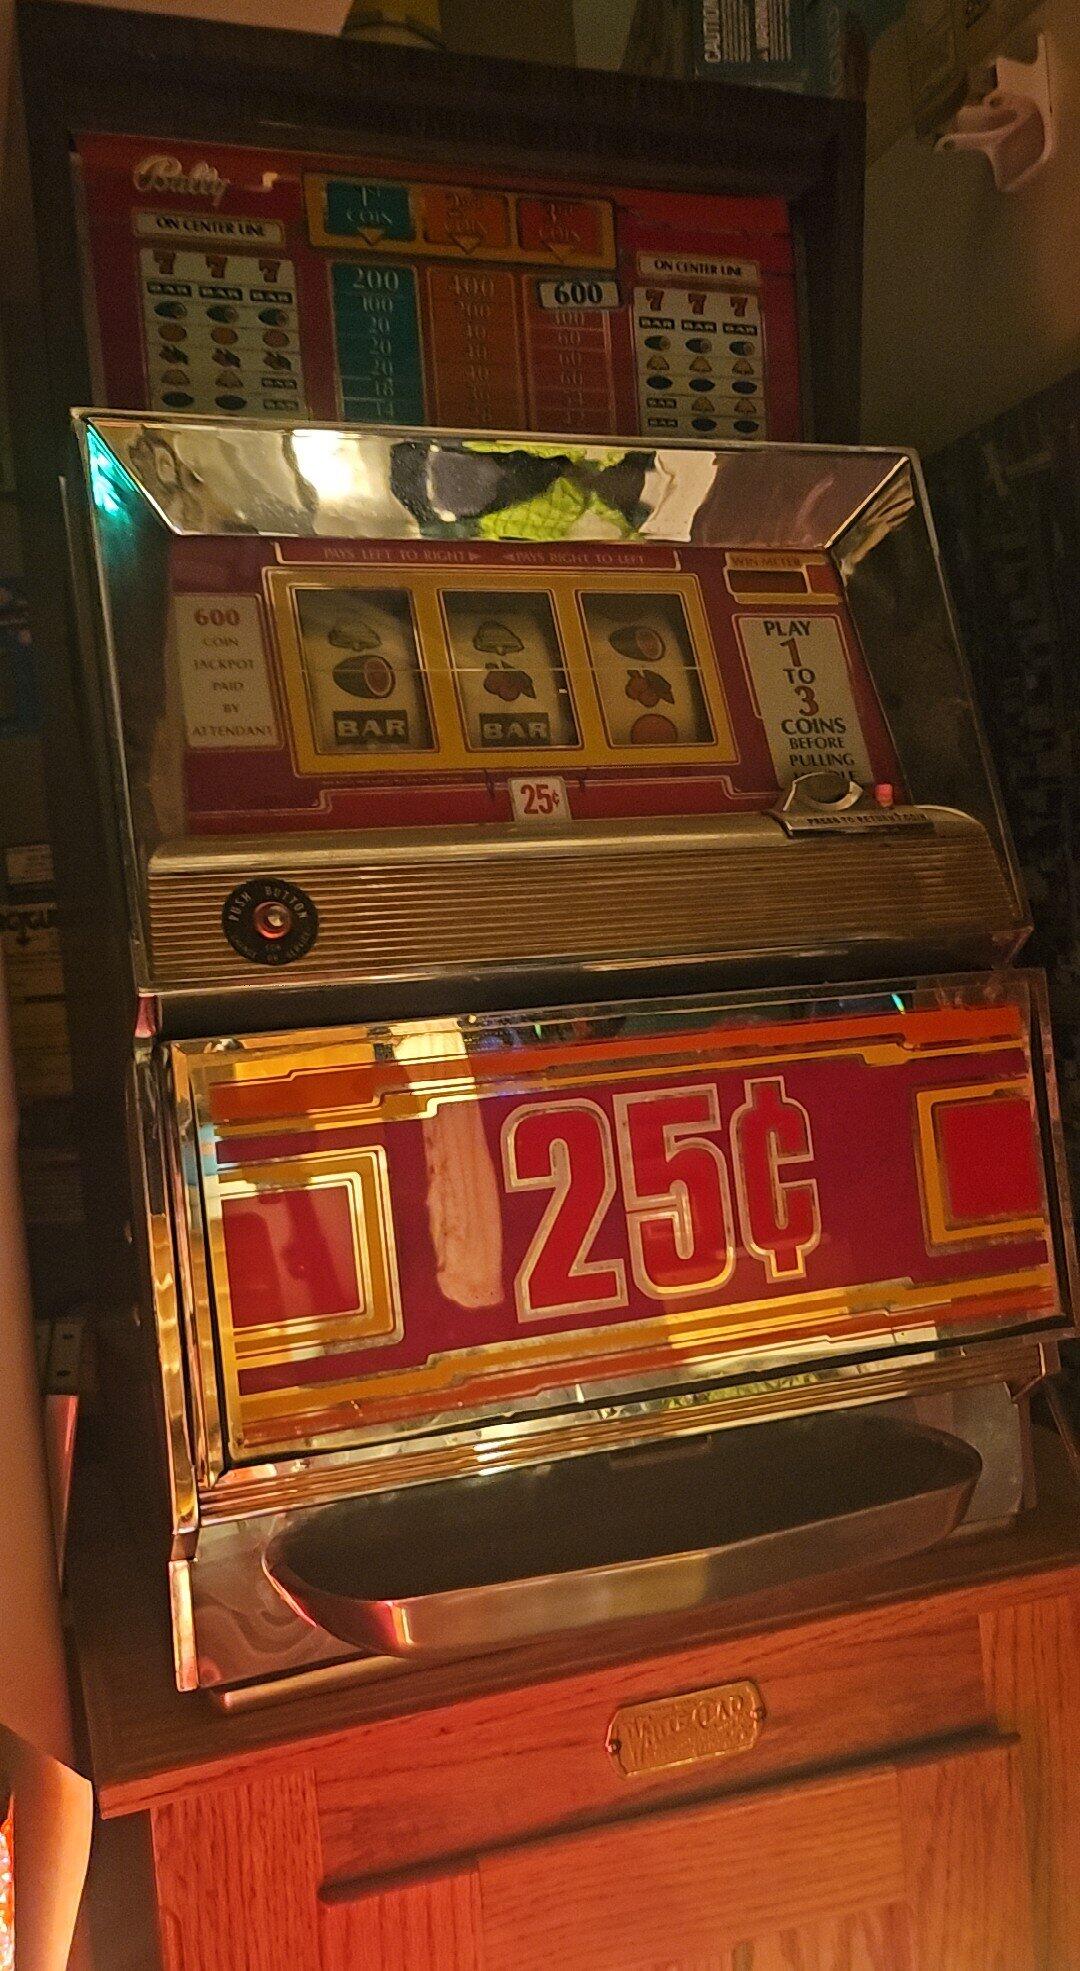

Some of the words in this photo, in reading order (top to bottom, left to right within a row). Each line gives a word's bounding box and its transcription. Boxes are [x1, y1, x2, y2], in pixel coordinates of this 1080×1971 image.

[133, 154, 230, 206] Bally
[156, 216, 179, 230] ON
[182, 219, 234, 235] CENTER
[238, 222, 264, 237] LINE
[206, 255, 228, 279] 7
[259, 259, 281, 283] 7
[654, 259, 673, 272] ON
[676, 262, 717, 275] CENTER
[720, 266, 742, 277] LINE
[353, 267, 400, 292] 200
[553, 282, 603, 304] 600
[362, 296, 395, 314] 100
[646, 289, 665, 312] 7
[688, 293, 707, 315] 7
[730, 296, 748, 317] 7
[369, 316, 391, 335] 20
[639, 317, 675, 330] BAR
[681, 320, 717, 334] BAR
[370, 337, 394, 355] 20
[371, 358, 394, 376] 20
[374, 378, 395, 398] 18
[361, 548, 393, 562] LEFT
[400, 549, 420, 562] TO
[423, 549, 466, 563] RIGHT
[594, 554, 614, 565] TO
[194, 609, 240, 626] 600
[763, 620, 812, 637] PLAY
[203, 636, 241, 647] COIN
[780, 638, 803, 668] 1
[193, 658, 255, 671] JACKPOT
[782, 668, 816, 685] TO
[213, 682, 246, 692] PAID
[222, 702, 239, 714] BY
[795, 686, 819, 717] 3
[192, 725, 273, 738] ATTENDANT
[336, 718, 407, 738] BAR
[483, 721, 548, 740] BAR
[780, 717, 847, 735] COINS
[789, 736, 845, 750] BEFORE
[789, 752, 856, 767] PULLING
[520, 783, 561, 815] 25¢
[227, 890, 252, 921] PUSH
[264, 884, 308, 919] BUTTON
[500, 1074, 822, 1324] 25¢
